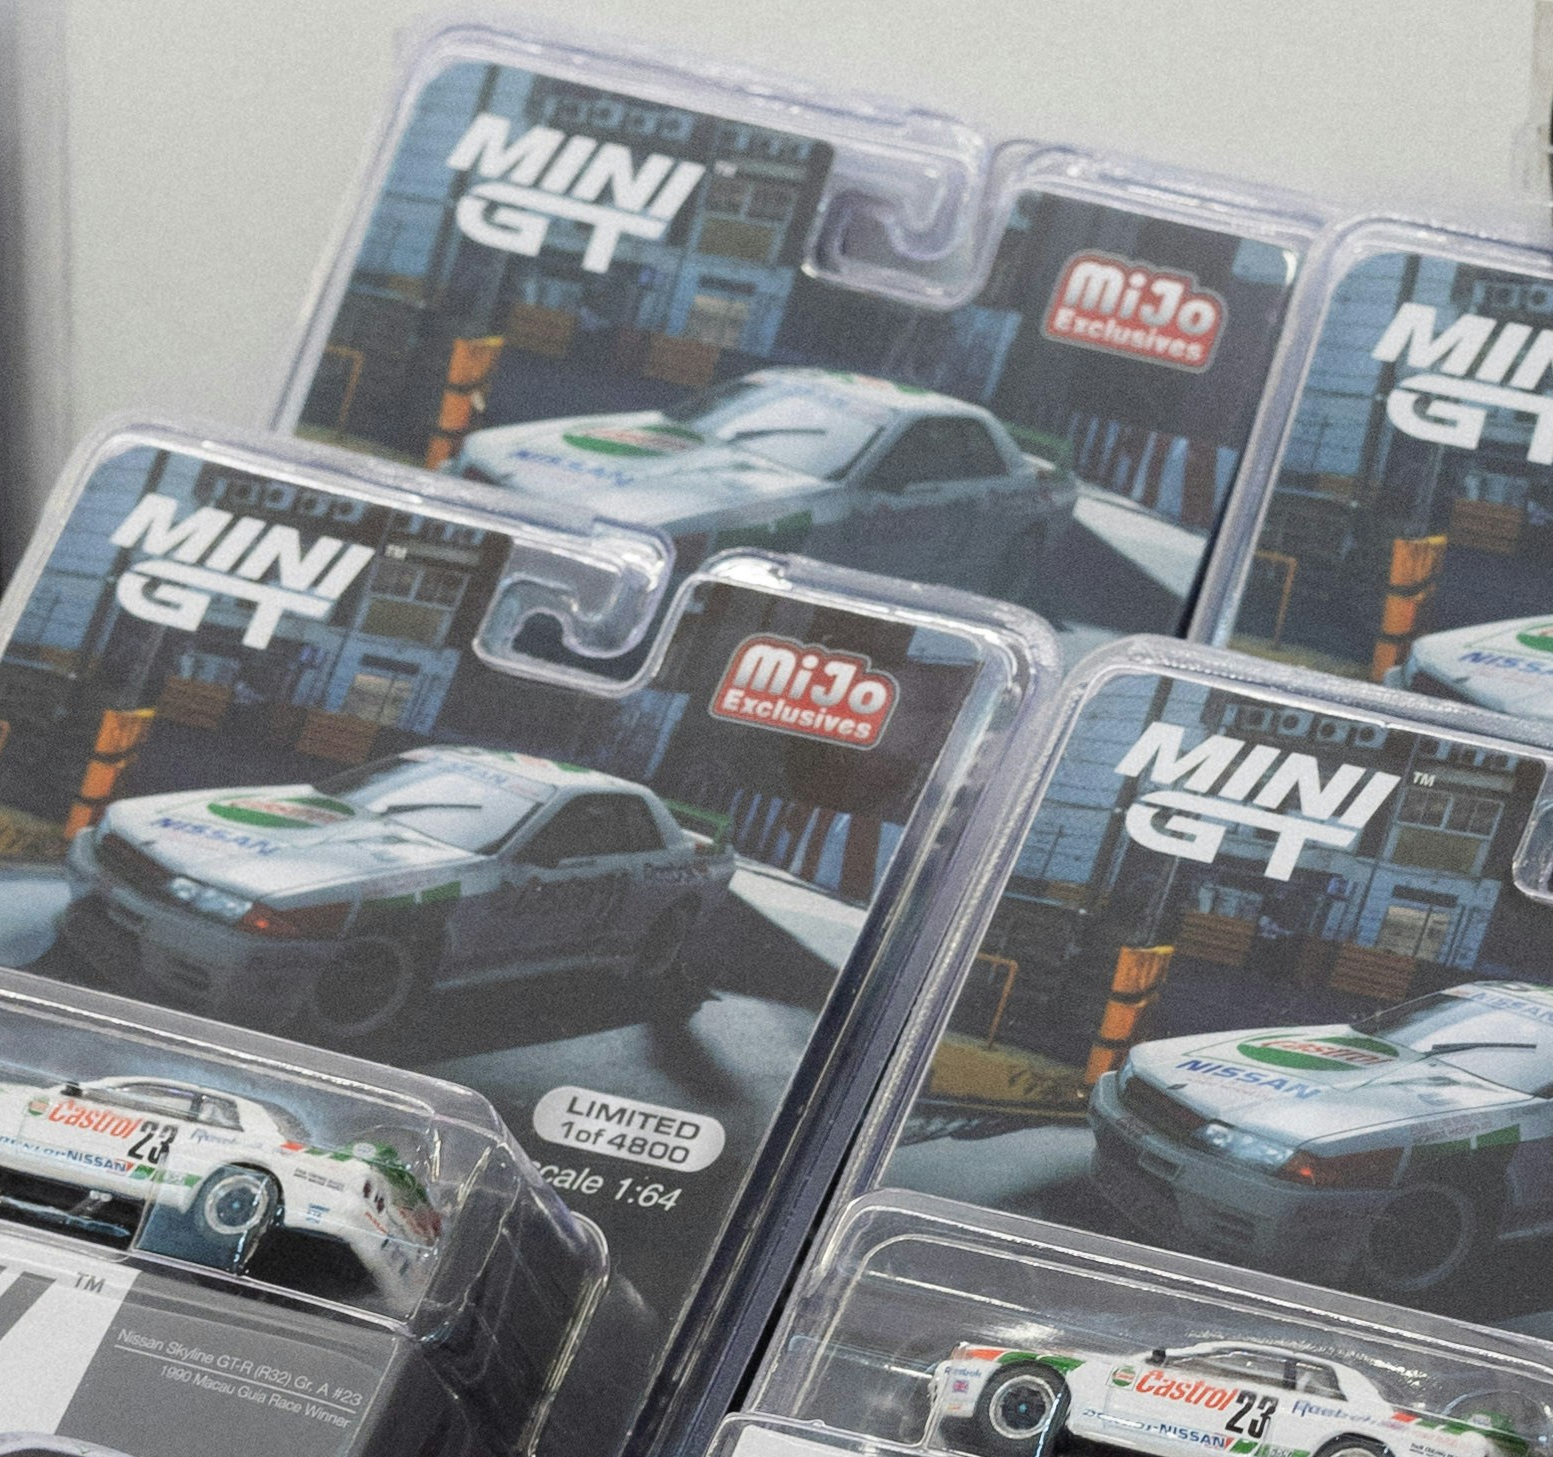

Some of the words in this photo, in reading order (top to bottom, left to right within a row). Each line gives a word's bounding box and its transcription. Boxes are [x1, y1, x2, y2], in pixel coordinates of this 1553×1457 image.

[447, 112, 706, 222] MINI
[456, 182, 668, 274] GT
[1054, 307, 1202, 360] Exclusives
[110, 493, 375, 598] MINI
[117, 559, 335, 650] GT
[722, 689, 872, 739] Exclusives
[1114, 721, 1402, 829] MINI
[151, 817, 279, 857] NISSAN
[1125, 790, 1358, 881] GT
[1175, 1058, 1321, 1102] NISSAN
[48, 1098, 141, 1141] Castrol
[566, 1097, 700, 1140] LIMITED
[66, 1149, 127, 1174] NISSAN
[608, 1133, 690, 1164] 4800
[615, 1178, 682, 1211] 1:64
[75, 1271, 106, 1294] TM
[1134, 1368, 1237, 1413] Castrol
[1156, 1422, 1225, 1450] NISSAN
[1225, 1390, 1278, 1438] 23
